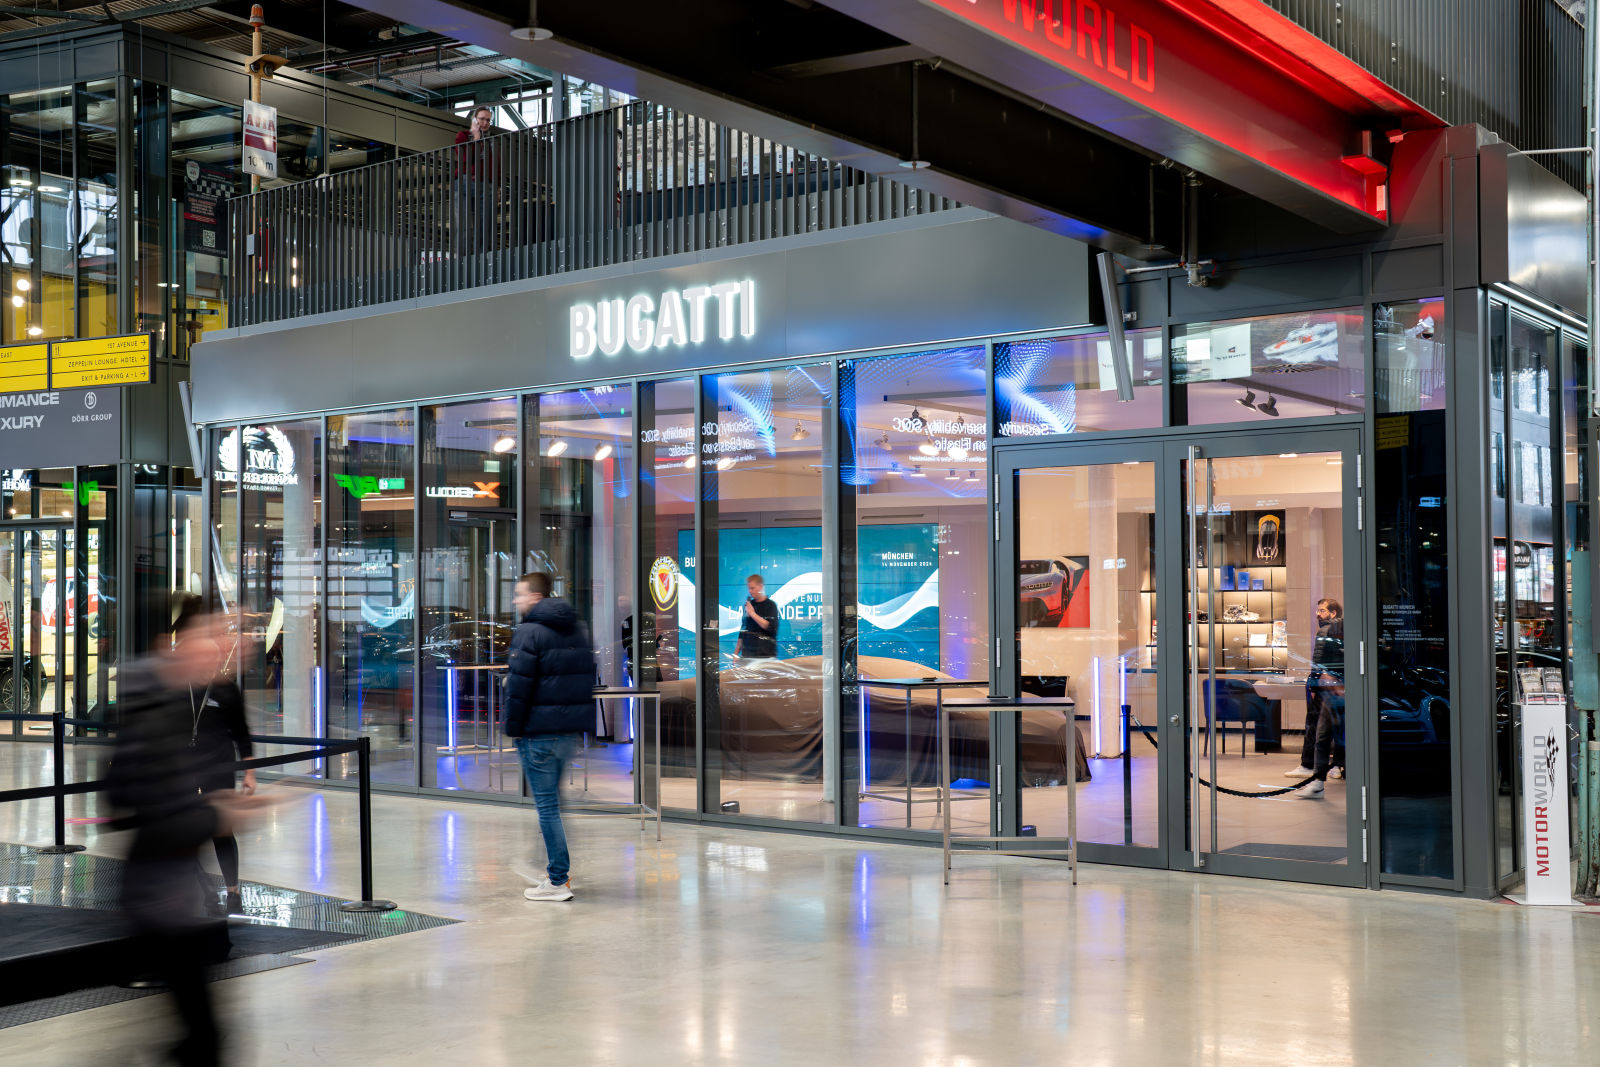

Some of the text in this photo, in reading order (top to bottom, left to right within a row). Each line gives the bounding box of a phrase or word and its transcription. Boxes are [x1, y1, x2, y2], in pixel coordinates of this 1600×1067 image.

[246, 114, 276, 131] AVIA
[570, 279, 755, 357] BUGATTI
[117, 340, 138, 348] AVENUE
[68, 360, 93, 368] ZEPPELIN
[0, 391, 60, 408] MANCE
[1, 415, 45, 430] XURY
[71, 413, 112, 422] DÖRR GROUP
[881, 552, 914, 560] MÜNCHEN
[1533, 735, 1550, 877] MOTORWORLD
